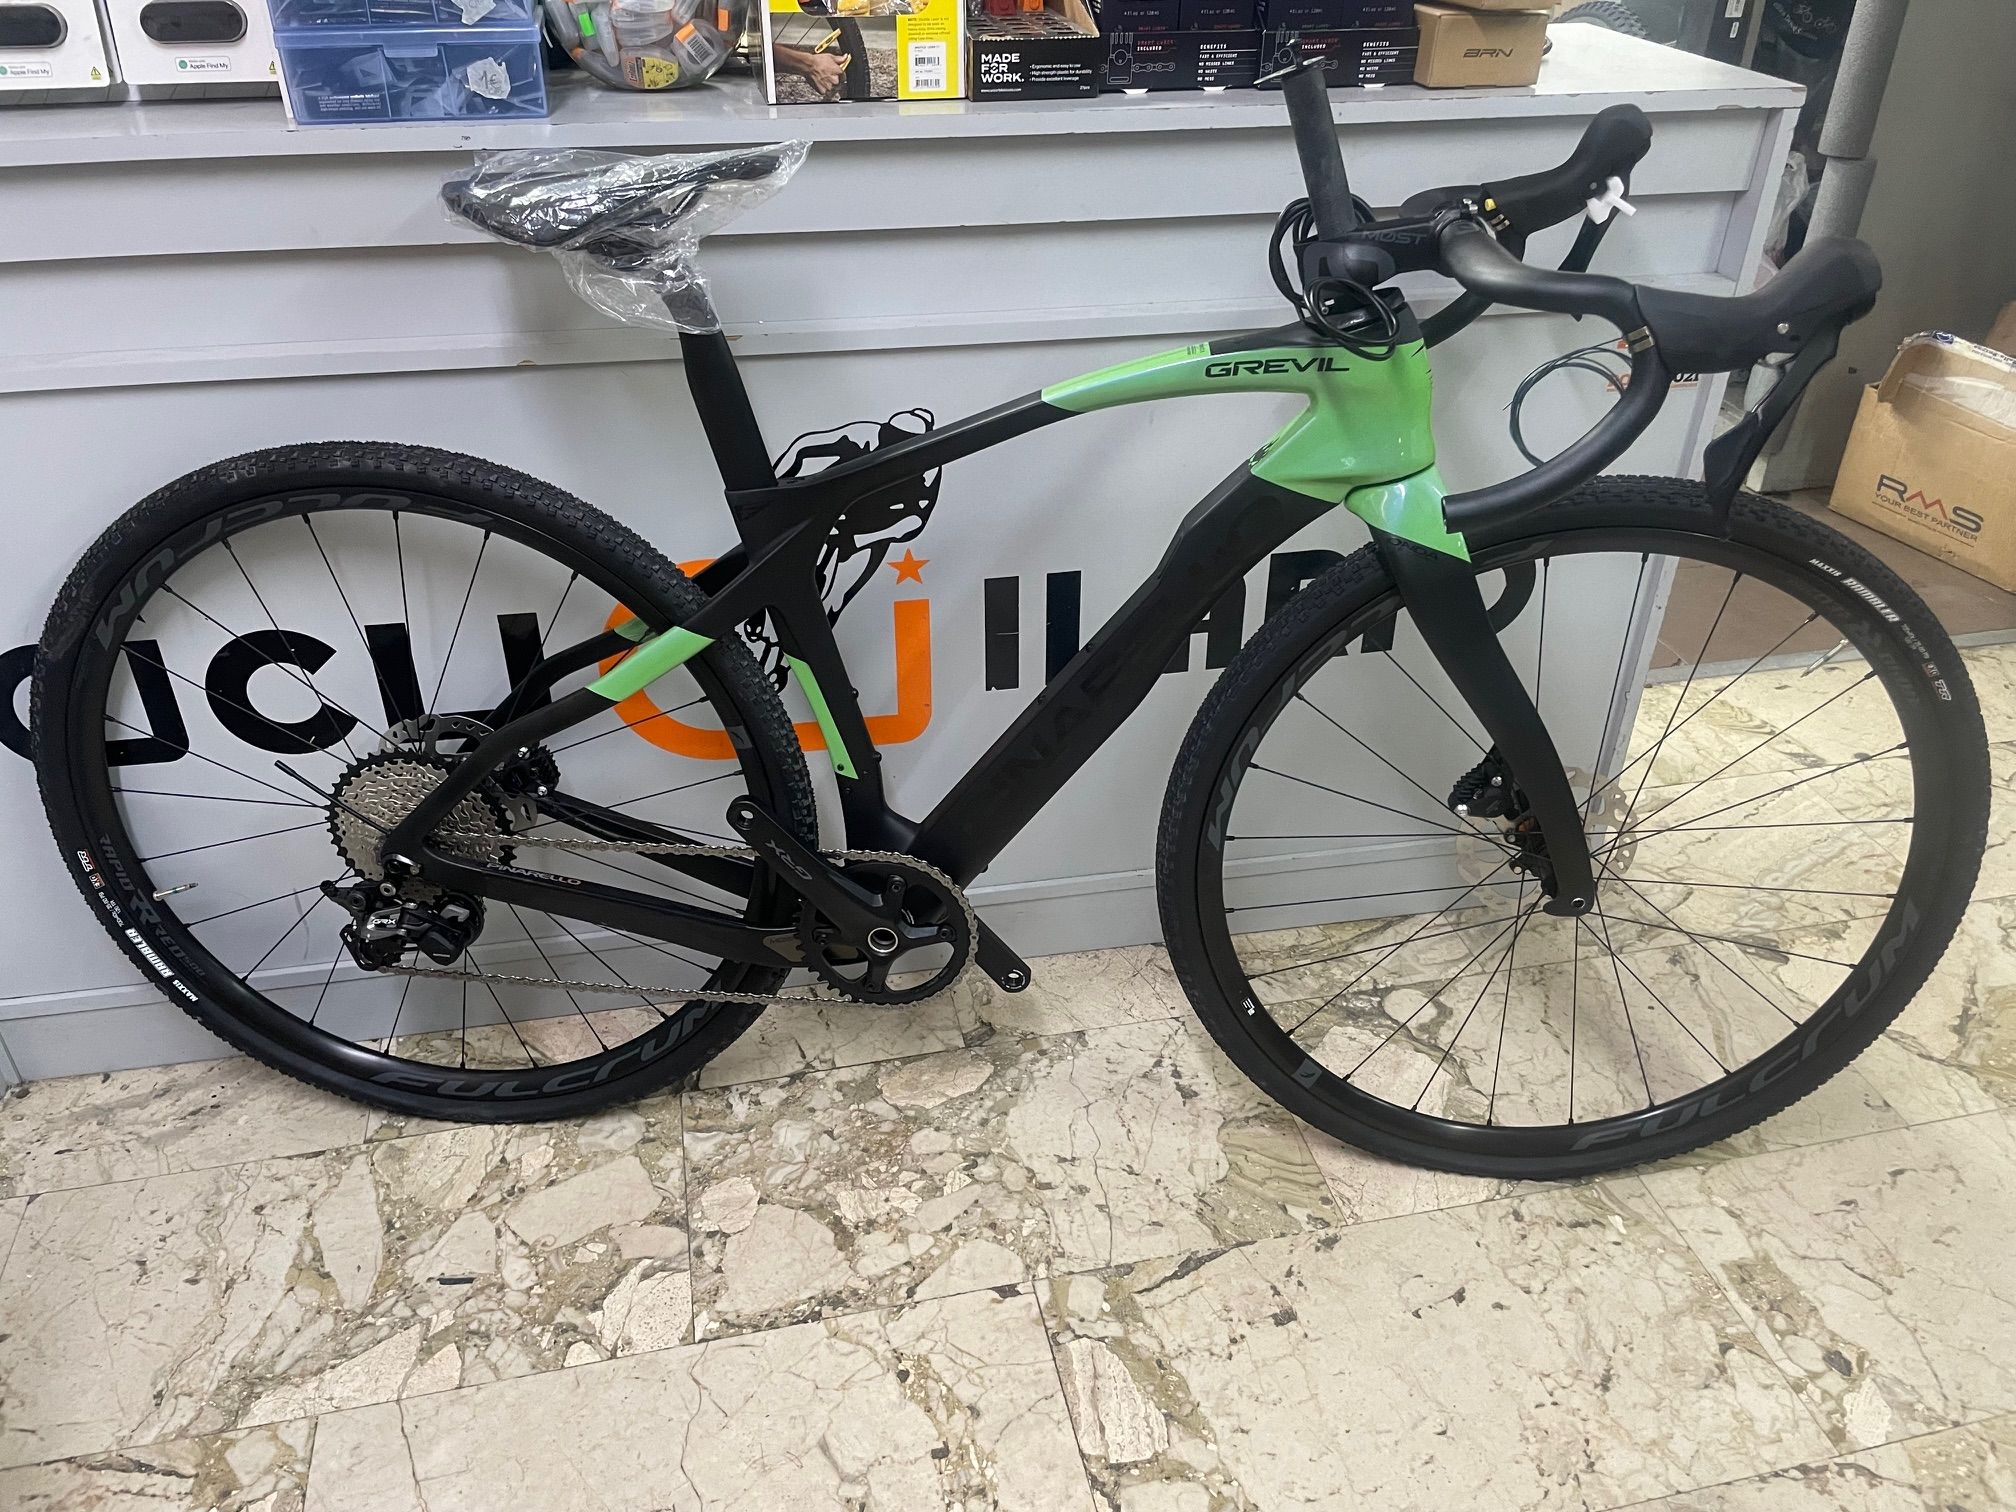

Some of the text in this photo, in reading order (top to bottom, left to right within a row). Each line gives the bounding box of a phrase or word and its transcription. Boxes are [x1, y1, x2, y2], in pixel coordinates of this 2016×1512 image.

[981, 53, 1020, 63] MADE
[1463, 48, 1513, 58] BRN
[981, 63, 1008, 74] FOR
[981, 73, 1025, 83] WORK.
[1205, 357, 1350, 378] GREVIL
[1877, 474, 1984, 533] RMS
[1875, 491, 1979, 542] YOUR BEST PARTNER
[1809, 558, 1843, 577] MAXXIS
[1840, 577, 1900, 622] RAMBLER
[764, 839, 813, 880] GRX
[125, 927, 175, 979] RAMBLER
[172, 979, 199, 1002] MAXXIS
[1570, 898, 1920, 1151] FULCRUM
